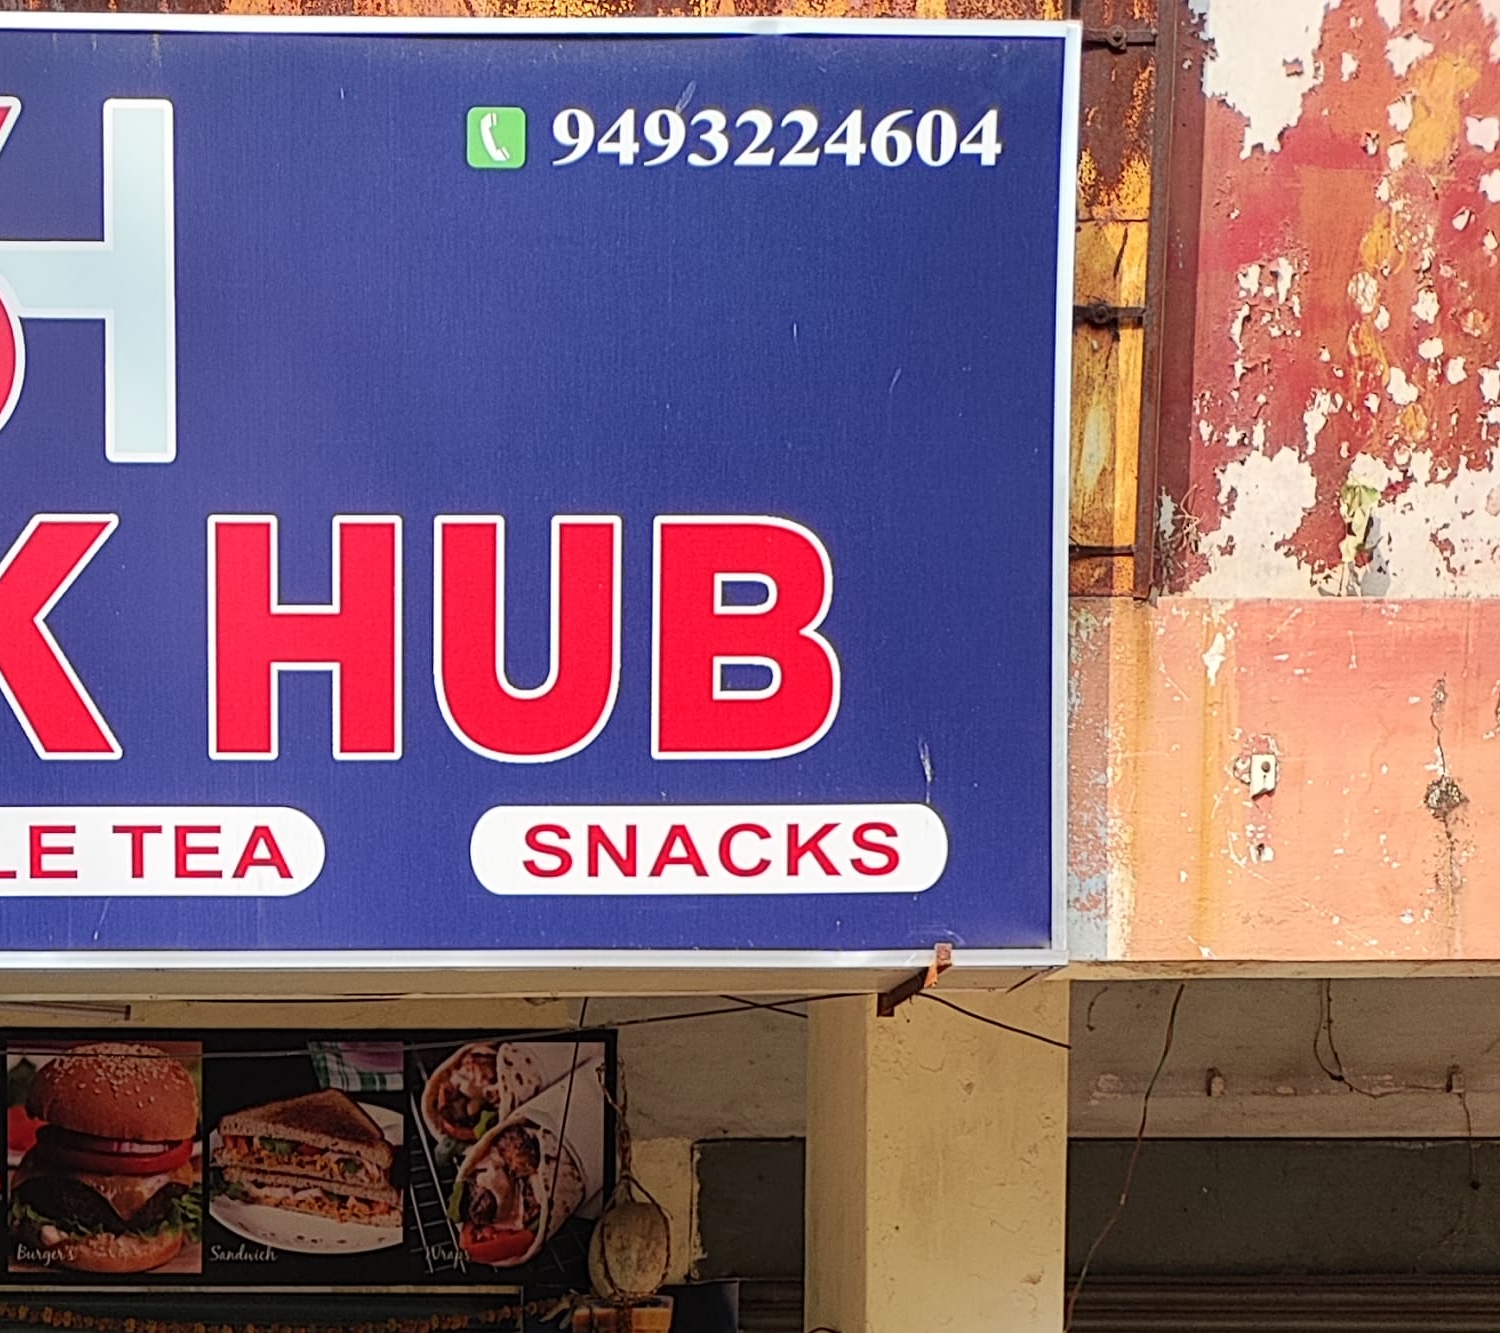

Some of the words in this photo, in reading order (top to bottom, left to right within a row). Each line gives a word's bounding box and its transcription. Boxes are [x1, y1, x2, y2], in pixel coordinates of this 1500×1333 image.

[552, 107, 1002, 167] 9493224604
[207, 513, 841, 765] HUB
[112, 824, 295, 881] TEA
[522, 821, 902, 880] SNACKS
[17, 1243, 76, 1266] Burger's
[209, 1243, 279, 1262] Sandwich
